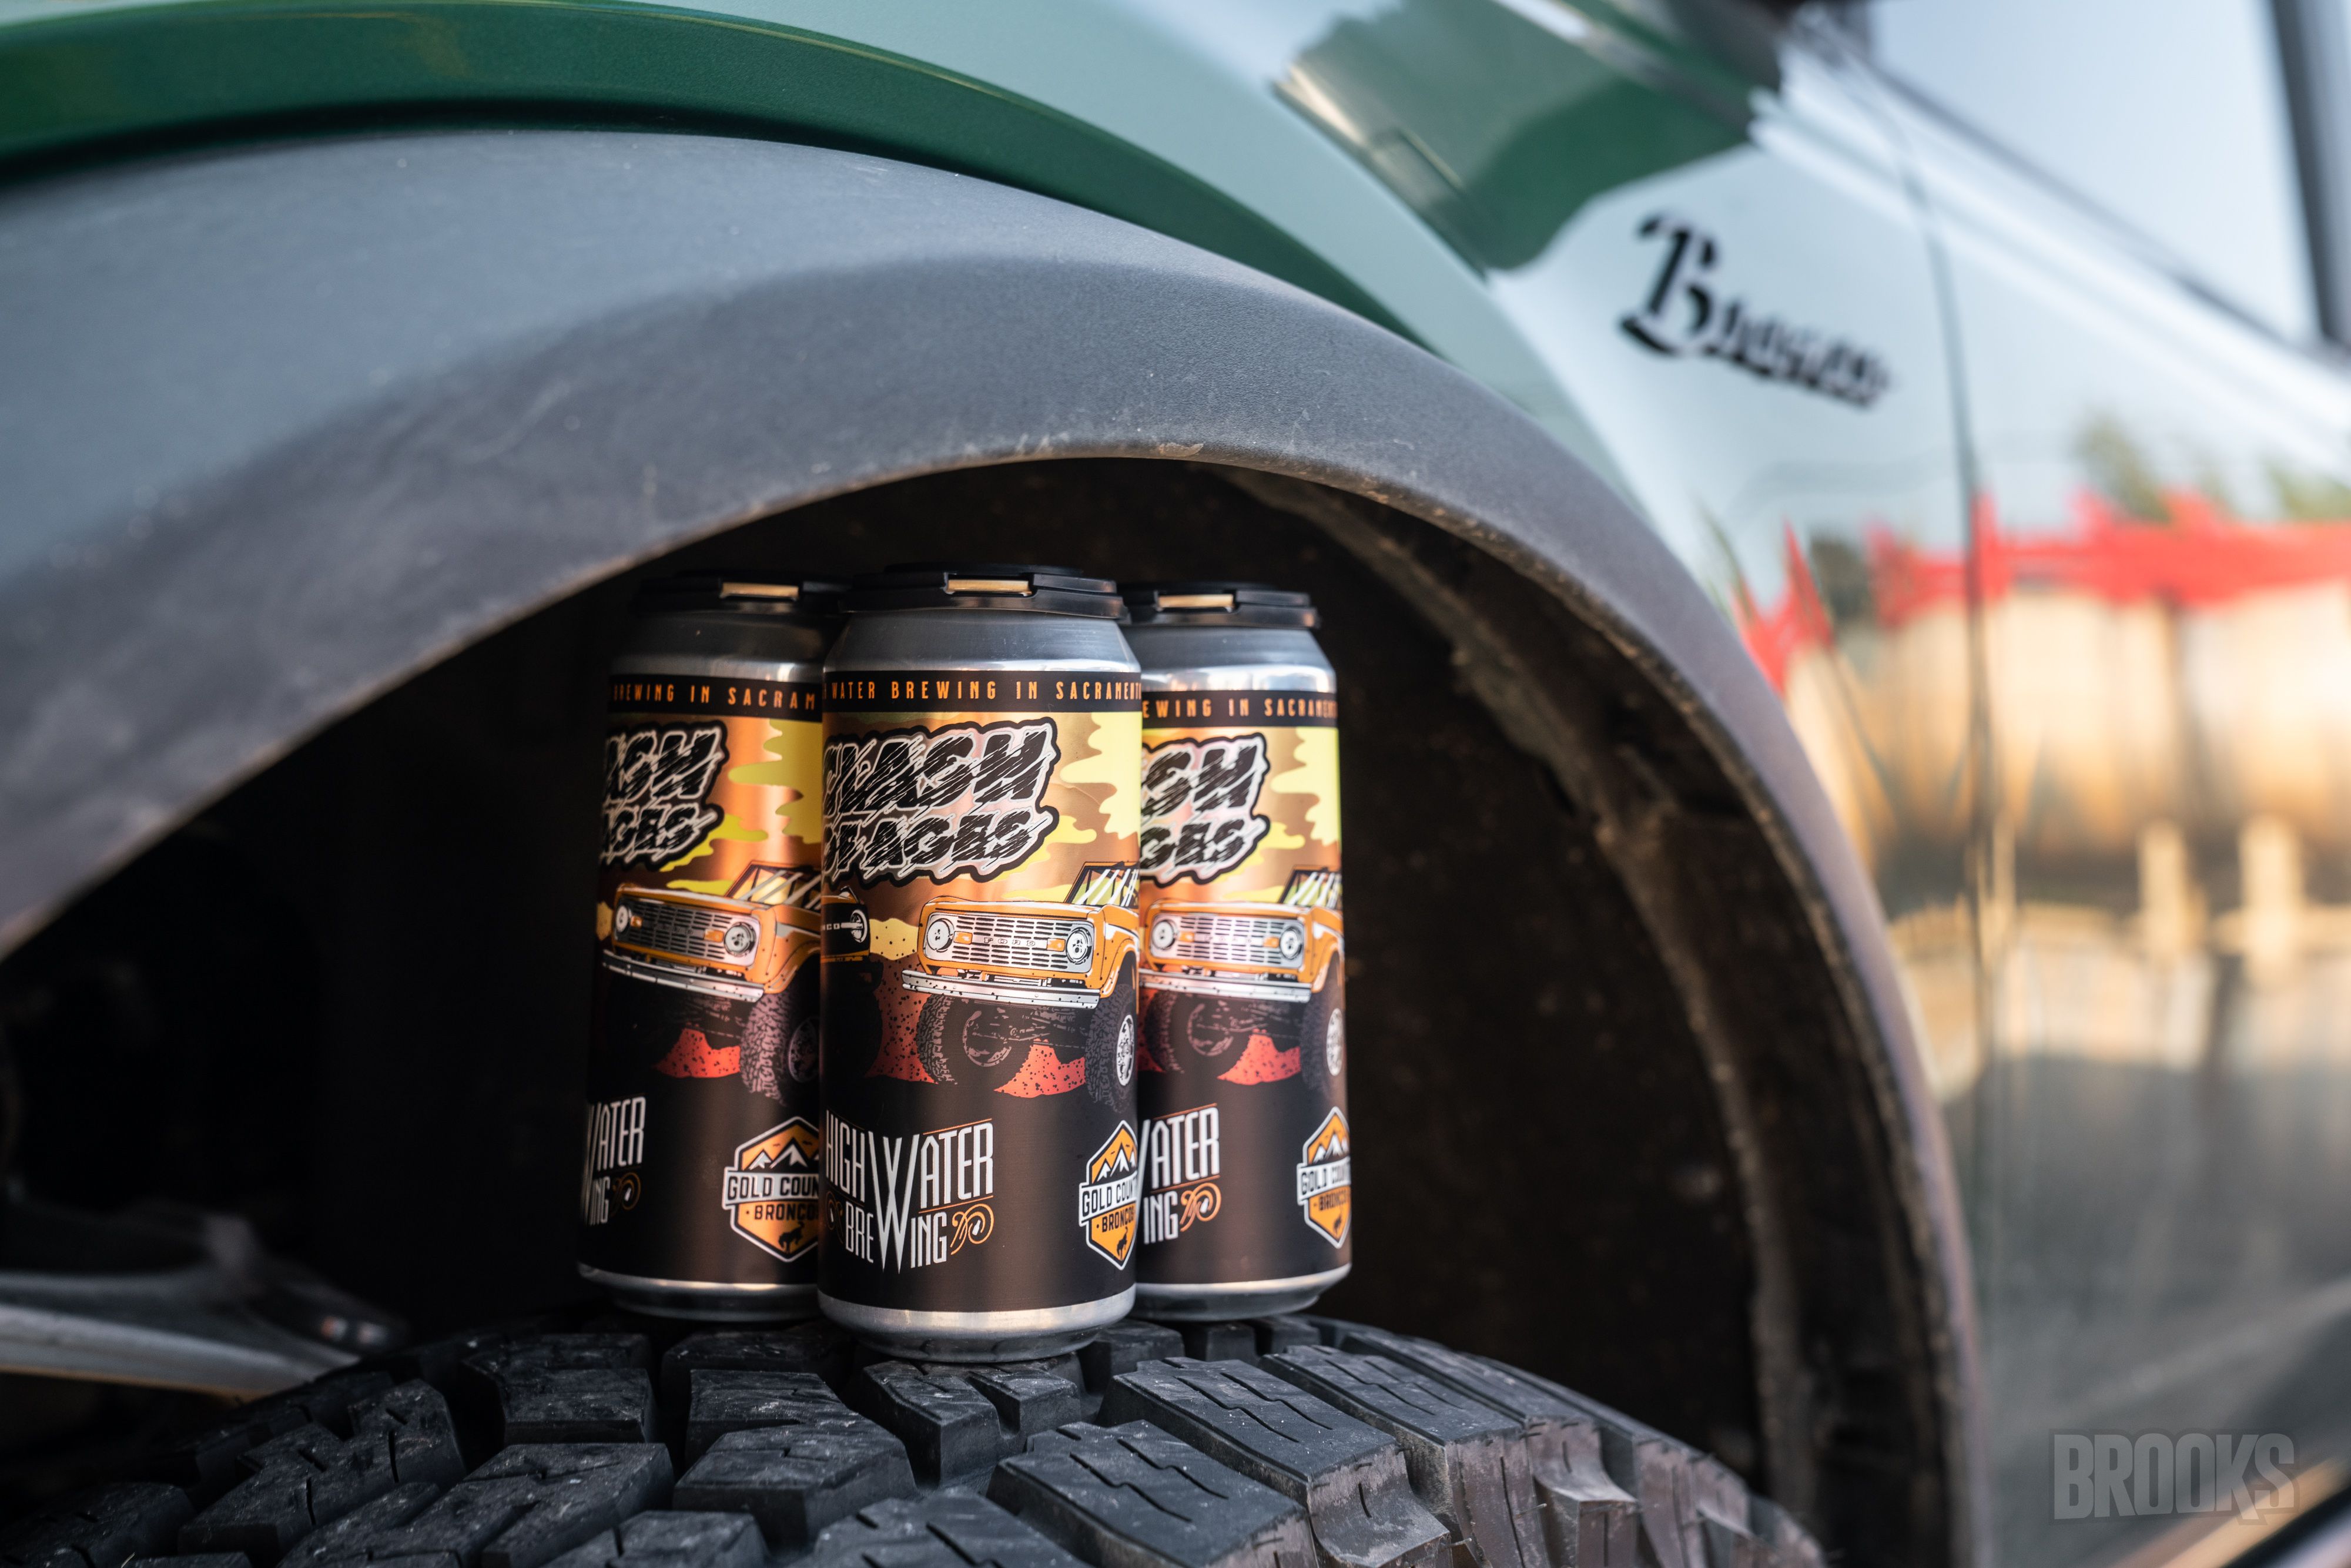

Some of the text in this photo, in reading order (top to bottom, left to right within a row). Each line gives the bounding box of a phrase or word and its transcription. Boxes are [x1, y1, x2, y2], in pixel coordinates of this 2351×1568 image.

[690, 685, 710, 703] IN
[728, 686, 815, 710] SACRAM
[832, 681, 875, 699] WATER
[891, 681, 996, 699] BREWING
[1016, 681, 1037, 699] IN
[1142, 698, 1212, 718] EWING
[1228, 698, 1249, 717] IN
[983, 937, 1036, 947] FORD
[727, 1175, 819, 1201] GOLD COUN
[826, 1109, 994, 1274] HIGH WATER
[1082, 1177, 1138, 1217] GOLD COUNT
[754, 1203, 818, 1221] BRONCO
